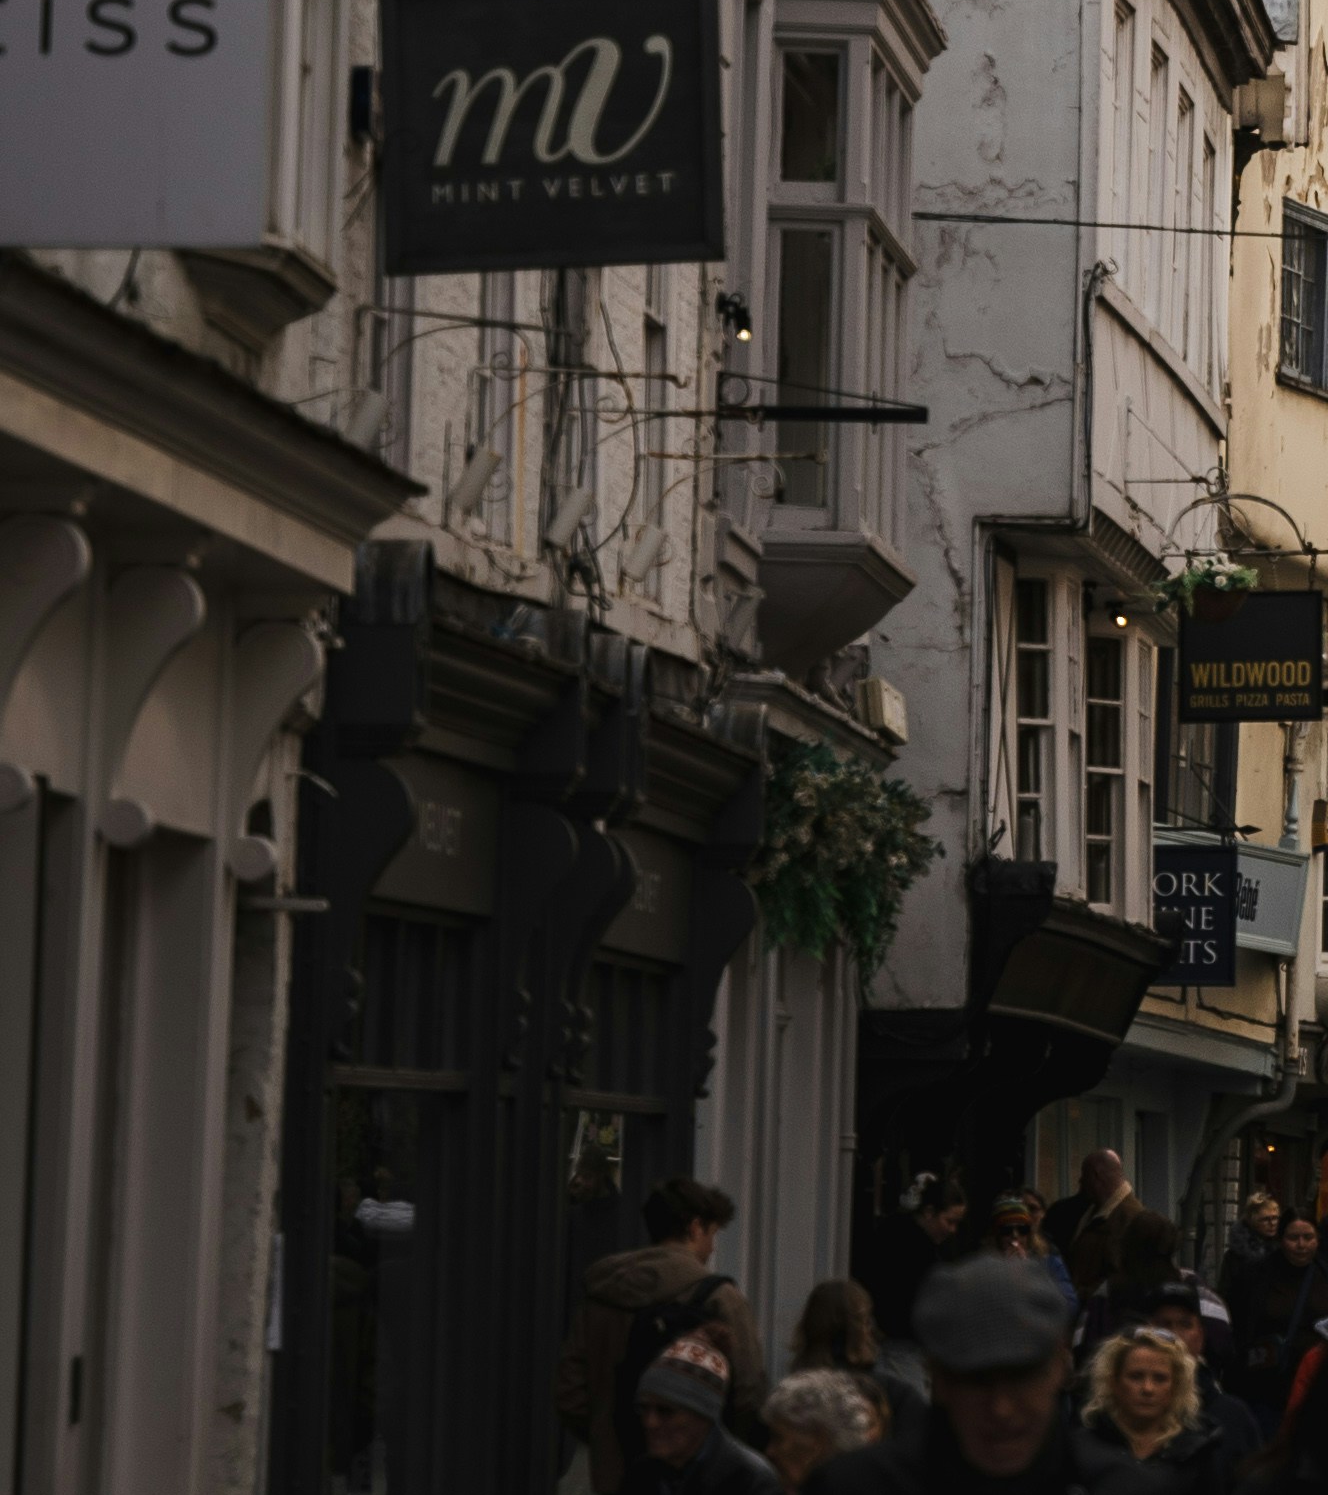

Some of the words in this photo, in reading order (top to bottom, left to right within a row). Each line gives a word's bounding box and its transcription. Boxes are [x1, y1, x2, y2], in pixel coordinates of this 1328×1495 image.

[431, 178, 524, 204] MINT
[542, 170, 677, 200] VELVET
[1190, 660, 1312, 688] WILDWOOD
[1189, 694, 1229, 708] GRILLS
[1235, 693, 1268, 707] PIZZA
[1275, 692, 1311, 707] PASTA
[1153, 872, 1225, 897] ORK
